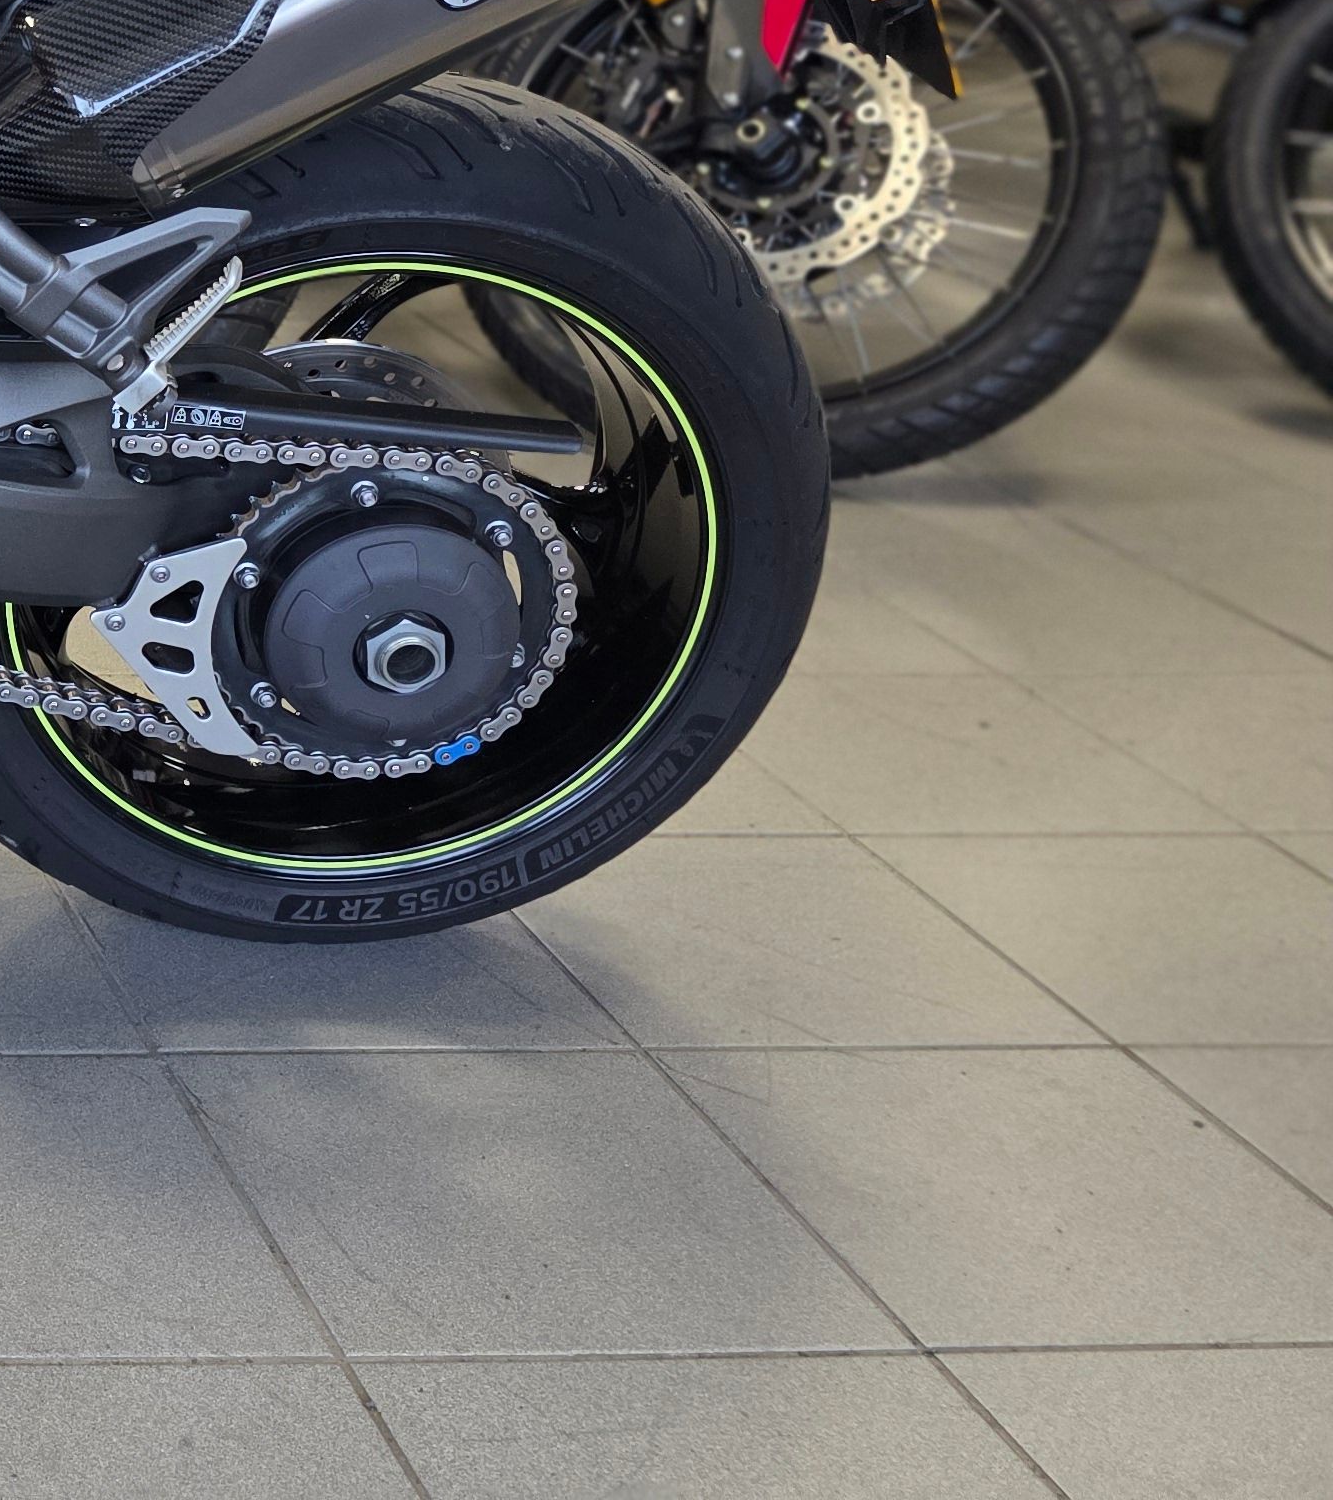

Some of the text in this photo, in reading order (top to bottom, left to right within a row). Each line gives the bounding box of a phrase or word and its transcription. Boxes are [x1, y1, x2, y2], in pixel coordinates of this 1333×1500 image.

[537, 757, 679, 871] MICHELIN
[339, 896, 385, 921] ZR
[397, 864, 514, 916] 190/55
[290, 898, 329, 921] 17
